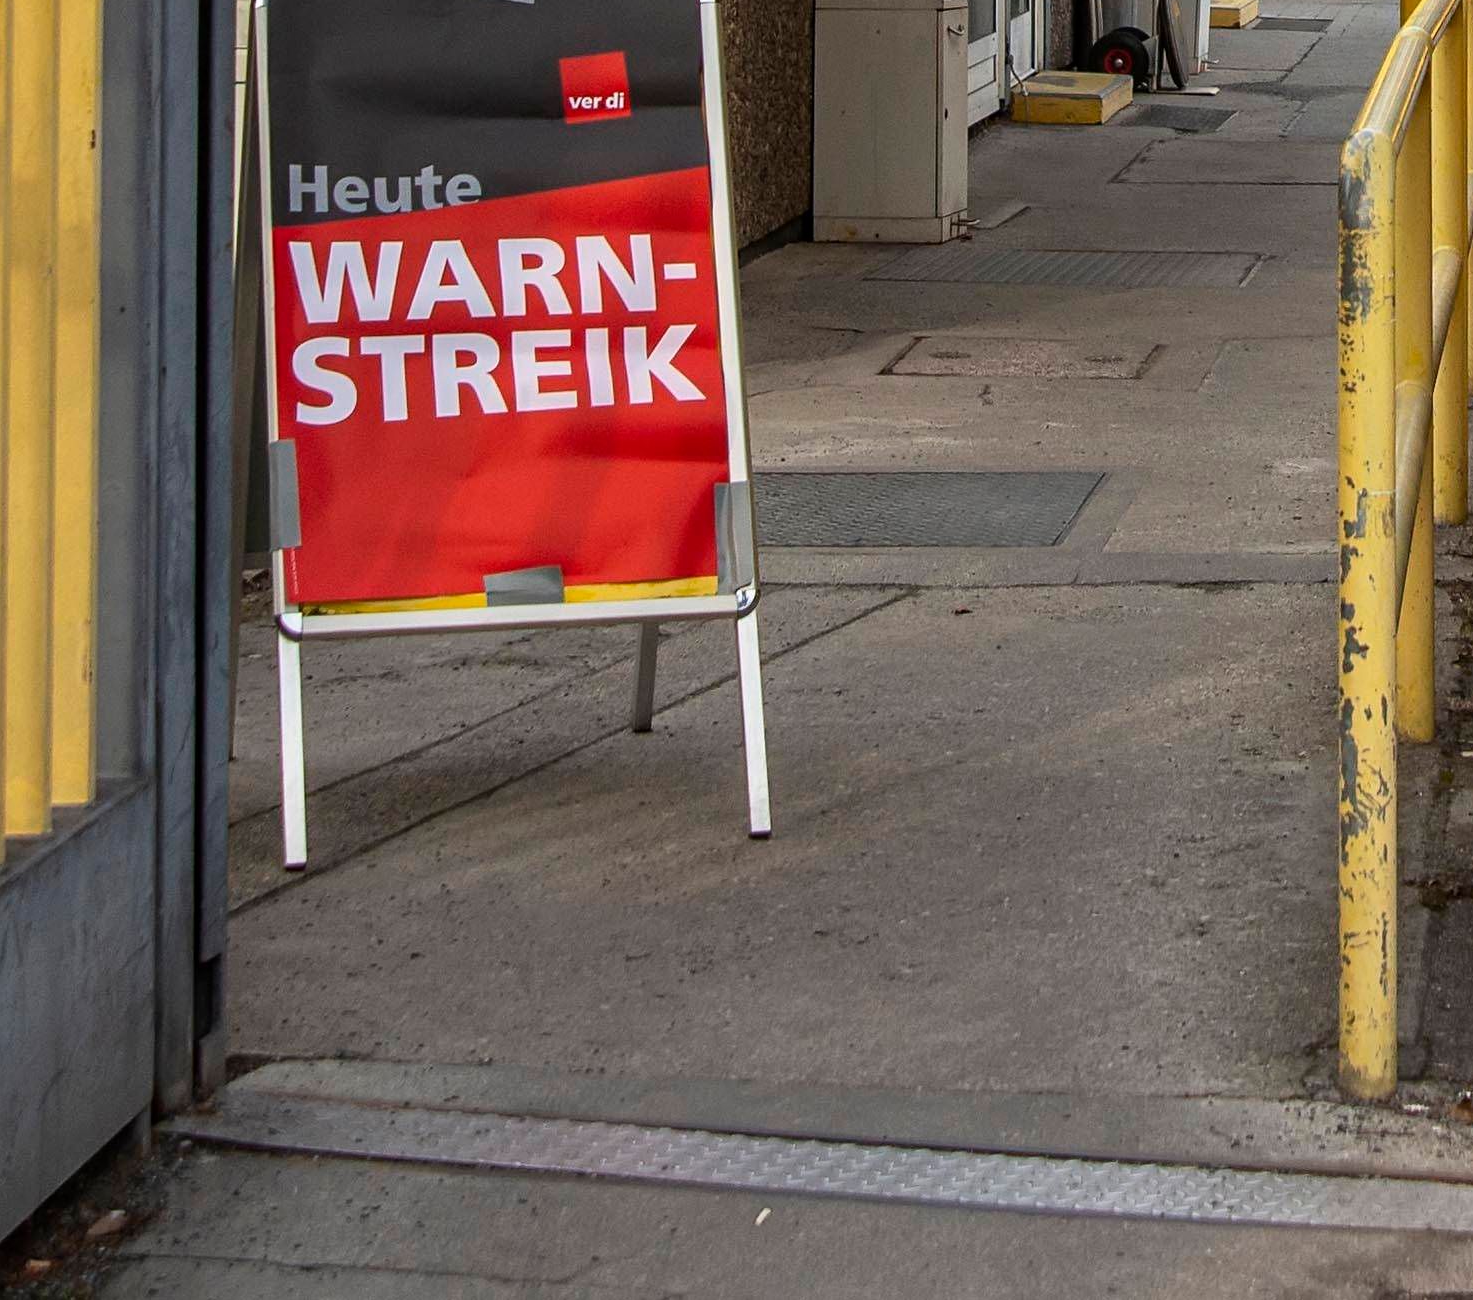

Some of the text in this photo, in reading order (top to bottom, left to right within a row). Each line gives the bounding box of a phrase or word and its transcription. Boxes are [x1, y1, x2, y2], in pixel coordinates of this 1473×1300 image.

[287, 163, 483, 215] Heute
[287, 233, 698, 325] WARN-
[290, 323, 707, 427] STREIK
